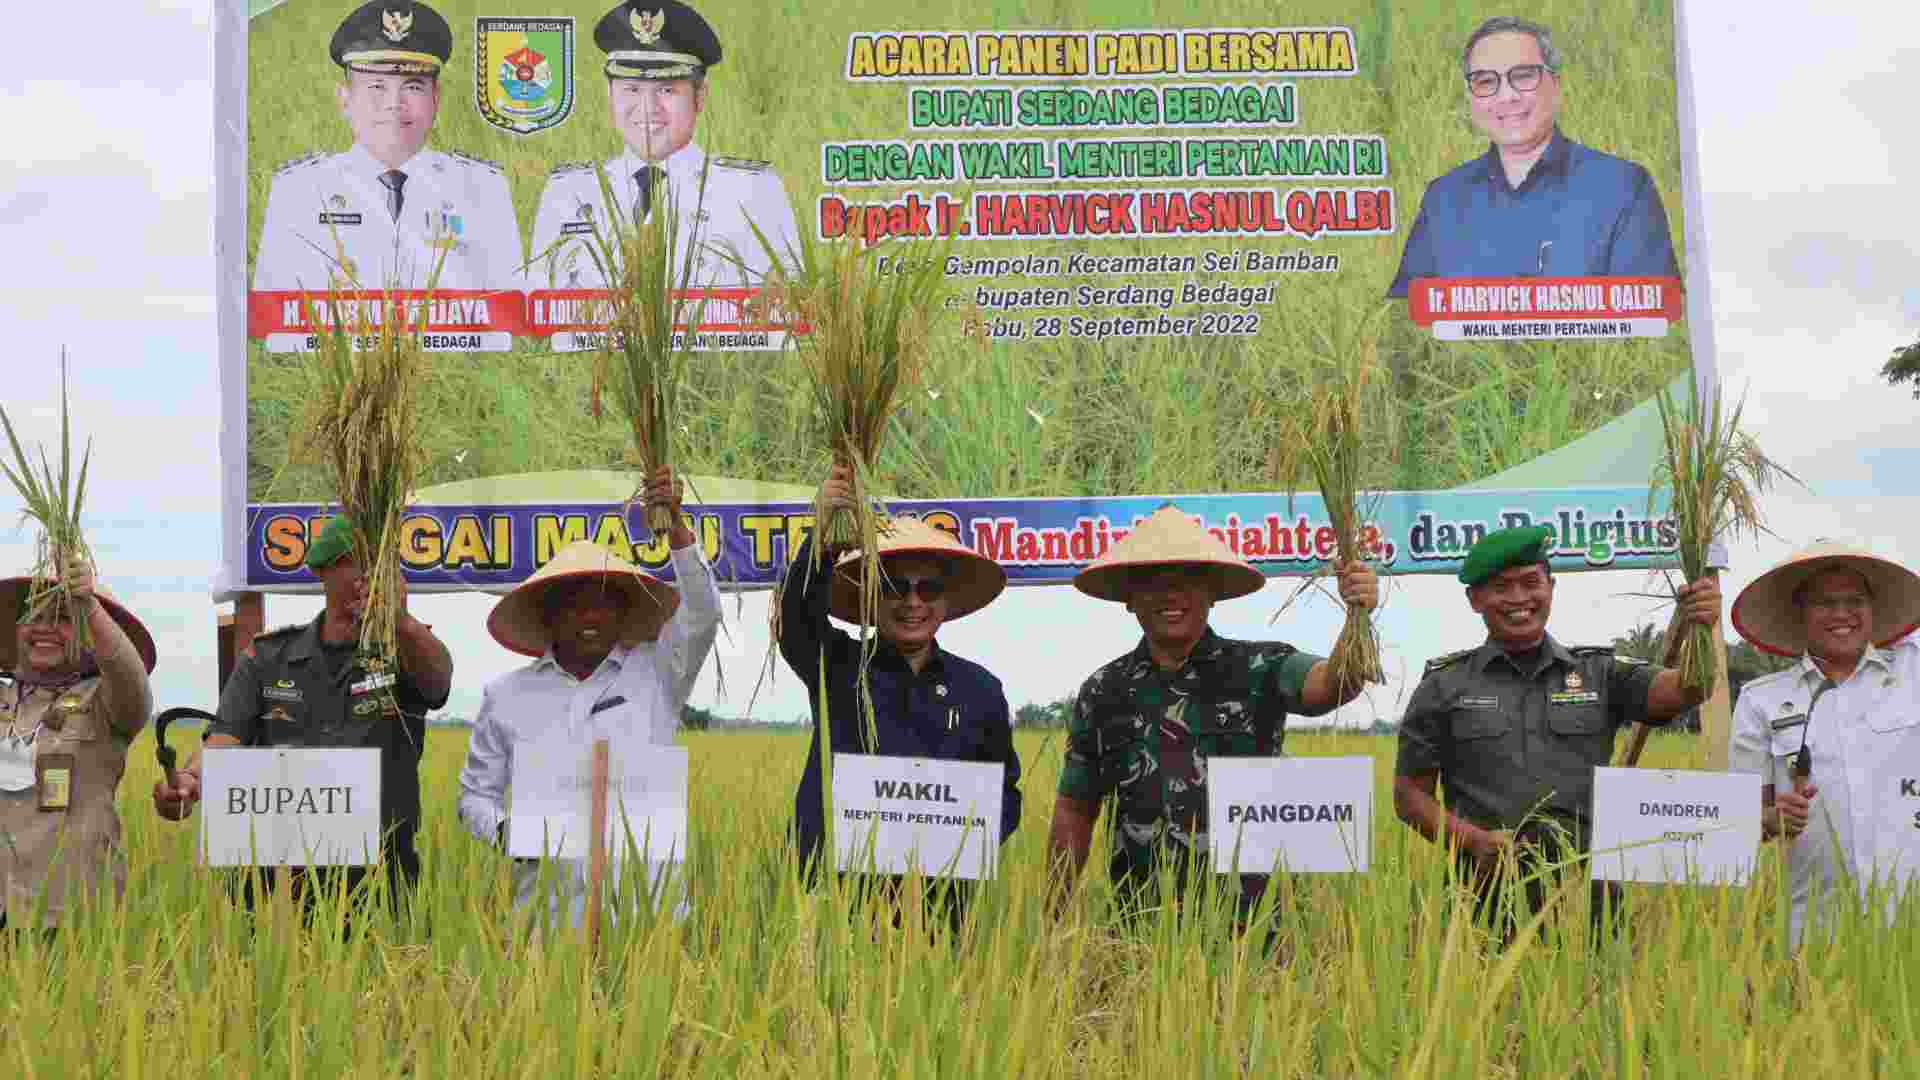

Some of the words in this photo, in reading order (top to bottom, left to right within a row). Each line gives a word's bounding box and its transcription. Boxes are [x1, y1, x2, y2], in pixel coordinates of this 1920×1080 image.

[850, 35, 972, 77] ACARA
[976, 34, 1088, 76] PANEN
[1095, 33, 1178, 74] PADI
[1184, 31, 1354, 72] BERSAMA
[911, 89, 1012, 127] BUPATI
[1017, 88, 1158, 126] SERDANG
[1163, 86, 1295, 124] BEDAGAI
[825, 145, 954, 182] DENGAN
[959, 143, 1055, 179] WAKIL
[1058, 141, 1182, 179] MENTERI
[1186, 139, 1350, 176] PERTANIAN
[1354, 139, 1383, 176] RI
[821, 194, 931, 248] Bapak
[936, 196, 971, 235] Ir.
[975, 193, 1137, 235] HARVICK
[1140, 191, 1285, 233] HASNUL
[1286, 190, 1393, 238] QALBI
[944, 254, 1060, 277] Gempolan
[1068, 250, 1196, 275] Kecamatan
[1203, 250, 1240, 272] Sei
[1246, 249, 1339, 272] Bamban
[1077, 284, 1175, 309] Serdang
[1181, 282, 1276, 308] Bedagai
[1428, 286, 1446, 313] Ir.
[1451, 286, 1533, 313] HARVICK
[1535, 285, 1606, 312] HASNUL
[1610, 284, 1663, 312] QALBI
[1034, 317, 1063, 337] 28
[1068, 314, 1196, 341] September
[1200, 313, 1260, 335] 2022
[1462, 323, 1499, 337] WAKIL
[1501, 322, 1551, 337] MENTERI
[1554, 322, 1617, 337] PERTANIAN
[1620, 321, 1632, 335] RI
[423, 335, 481, 349] BEDAGAI
[227, 786, 353, 815] BUPATI
[874, 779, 959, 804] WAKIL
[844, 808, 903, 824] MENTERI
[1228, 804, 1353, 823] PANGDAM
[1639, 802, 1720, 820] DANDREM
